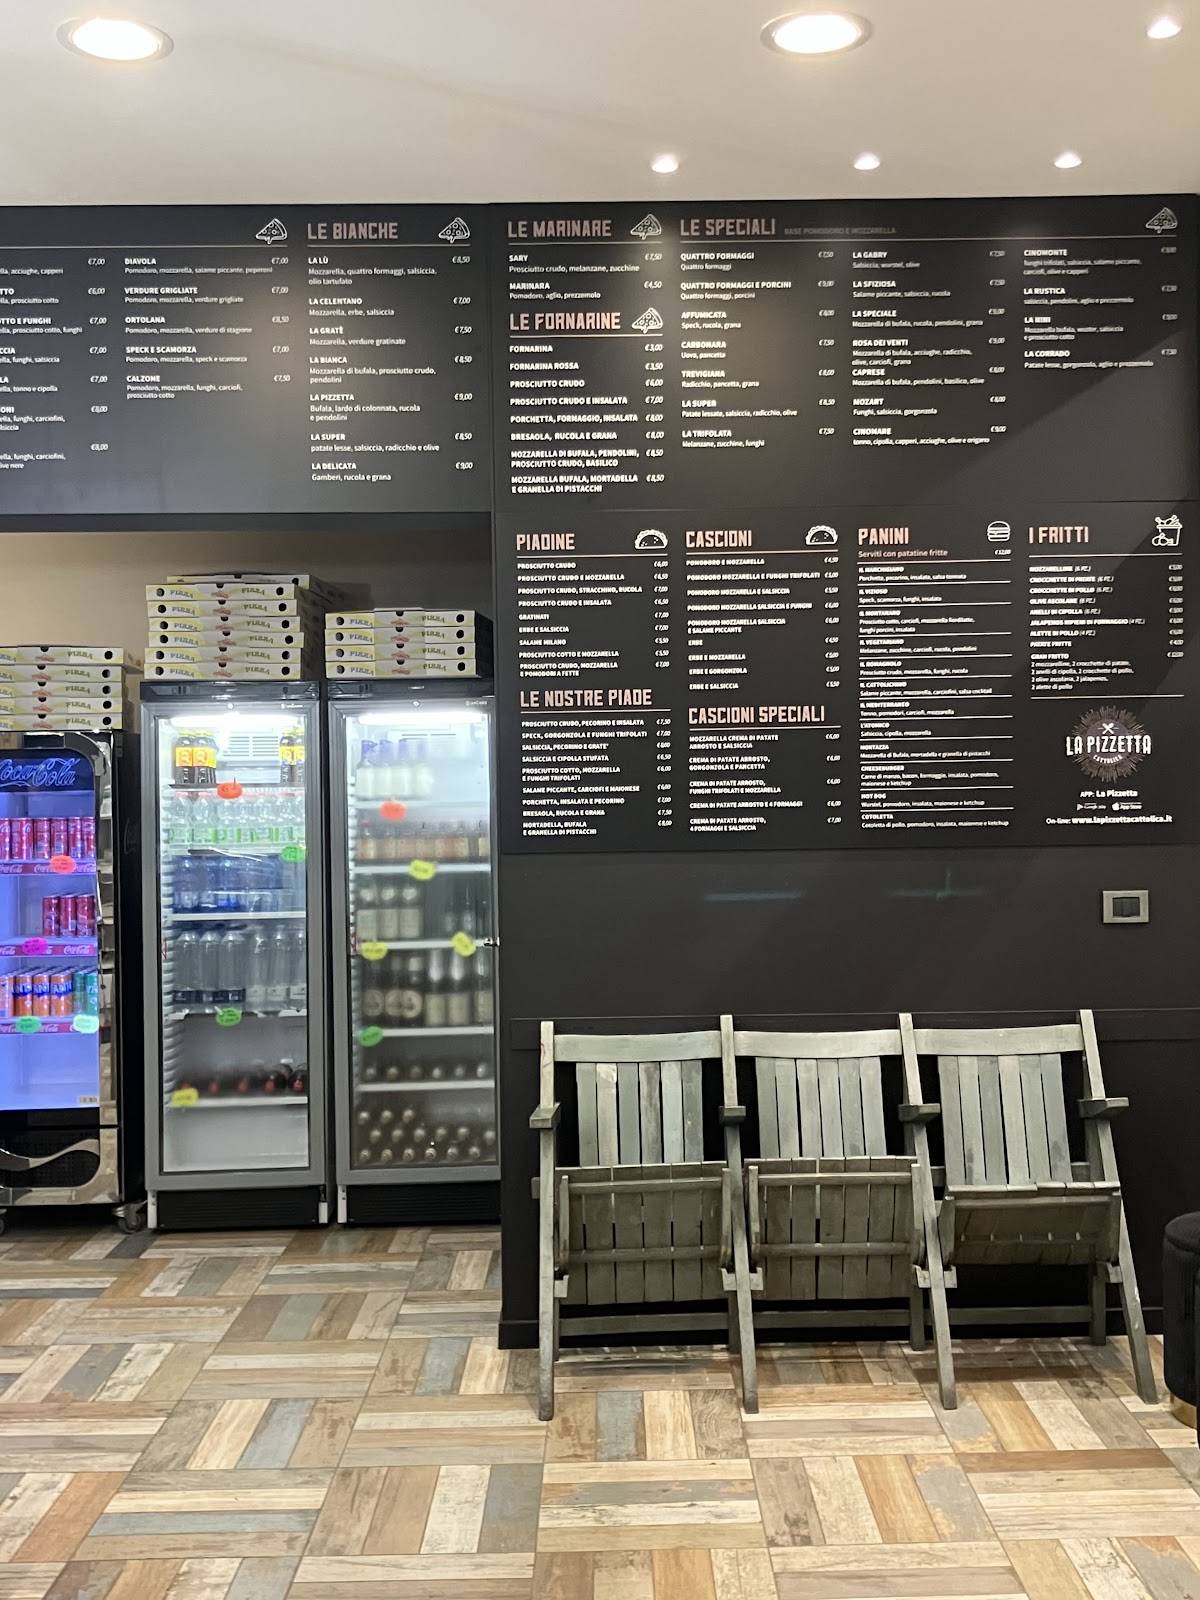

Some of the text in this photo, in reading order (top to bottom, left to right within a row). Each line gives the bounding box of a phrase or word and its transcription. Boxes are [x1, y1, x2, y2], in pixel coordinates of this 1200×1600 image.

[308, 222, 398, 239] LE BIANCHE
[508, 220, 612, 238] LE MARINARE
[680, 218, 775, 236] LE SPECIALI
[509, 254, 528, 262] SARY
[680, 252, 754, 261] QUATTRO FORMAGGI
[863, 280, 896, 288] SFIZIOSA
[681, 311, 727, 319] AFFUMICATA
[510, 312, 621, 330] LE FORNARINE
[63, 326, 82, 334] funghi
[681, 370, 725, 378] TREVIGIANA
[852, 368, 885, 376] CAPRESE
[310, 376, 342, 384] pendolini
[510, 379, 585, 388] PROSCIUTTO CRUDO
[37, 385, 58, 393] cipolla
[315, 414, 347, 422] pendolini
[510, 414, 638, 424] PORCHETTA, FORMAGGIO, INSALATA
[511, 433, 552, 441] BRESAOLA,
[554, 432, 585, 440] RUCOLA
[682, 430, 692, 438] LA
[322, 462, 357, 470] DELICATA
[372, 474, 391, 482] grana
[511, 474, 638, 484] MOZZARELLA BUFALA, MORTADELLA
[517, 485, 555, 493] GRANELLA
[564, 484, 602, 492] PISTACCHI
[686, 530, 752, 548] CASCIONI
[858, 527, 909, 545] PANINI
[1029, 526, 1088, 543] I FRITTI
[517, 533, 575, 550] PIADINE
[858, 550, 882, 558] Serviti
[897, 549, 928, 558] patatine
[520, 689, 652, 707] LE NOSTRE PIADE
[689, 705, 824, 724] CASCIONI SPECIALI
[1066, 734, 1151, 756] LA PIZZETTA
[1107, 789, 1138, 797] Pizzetta
